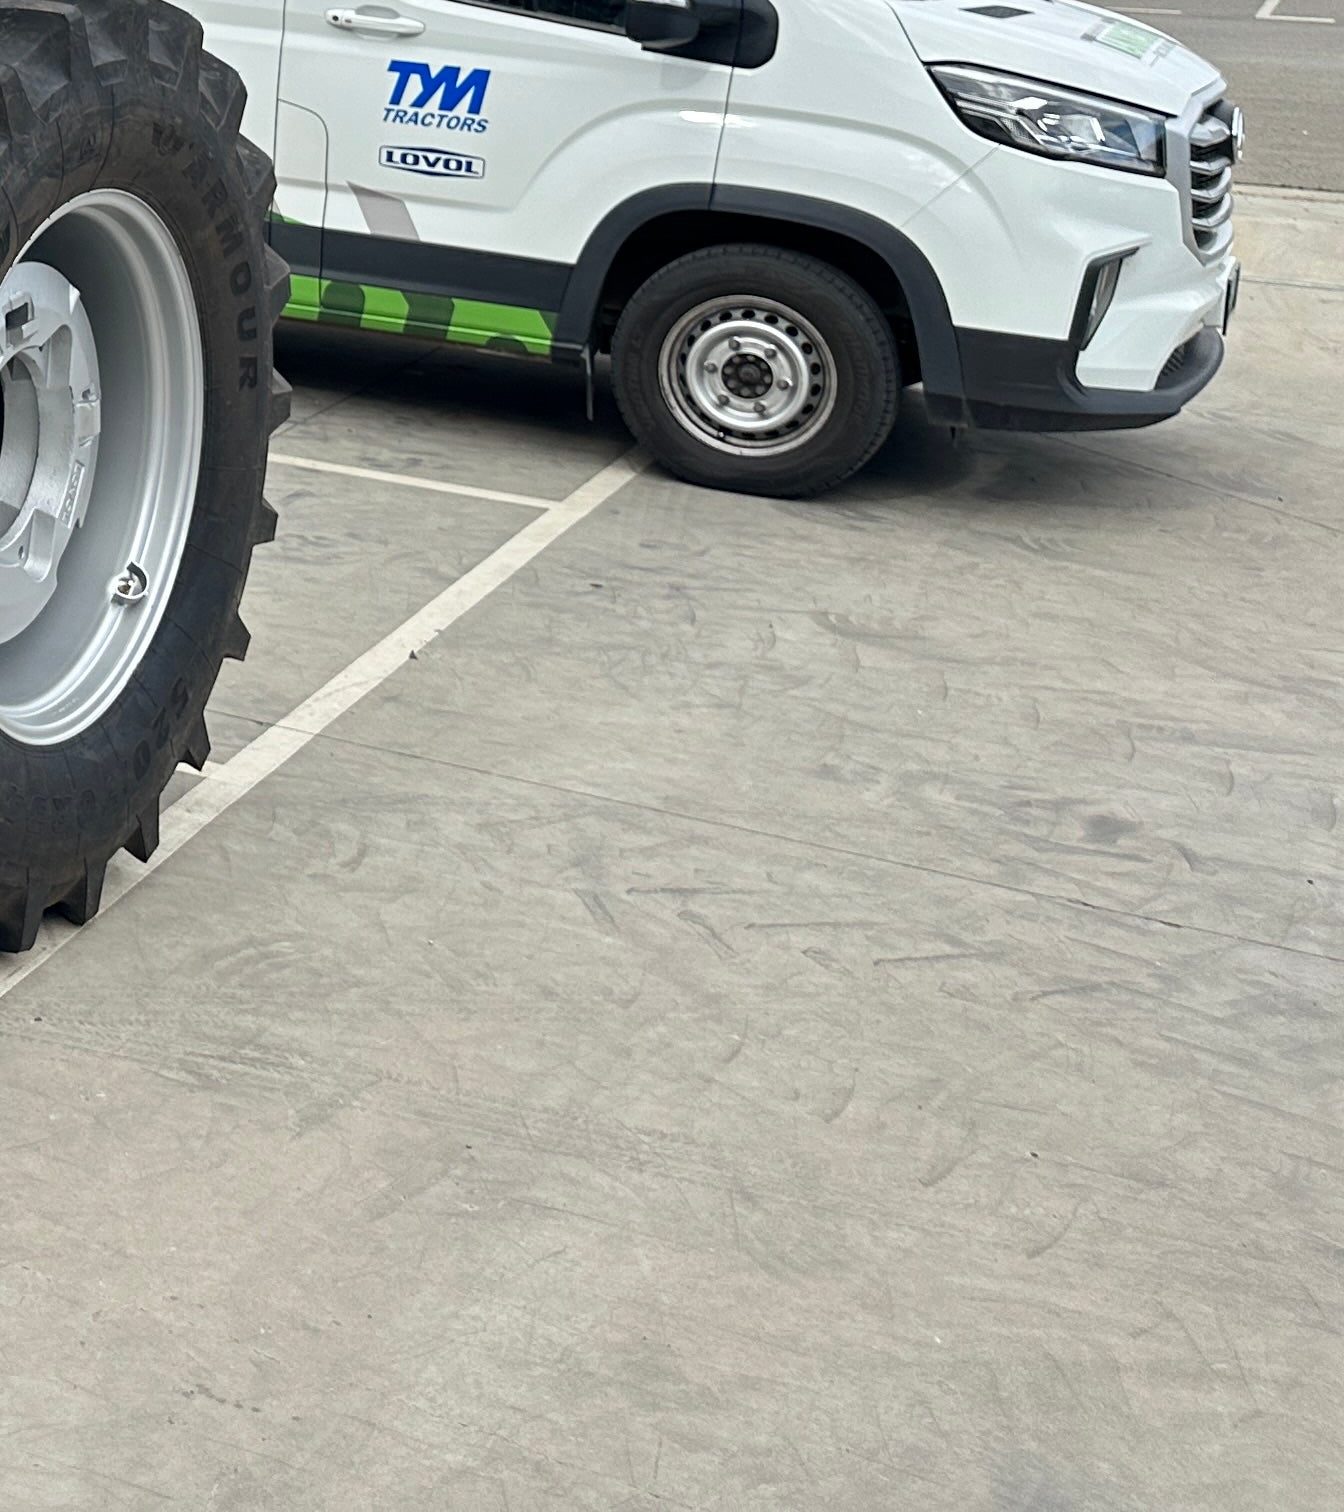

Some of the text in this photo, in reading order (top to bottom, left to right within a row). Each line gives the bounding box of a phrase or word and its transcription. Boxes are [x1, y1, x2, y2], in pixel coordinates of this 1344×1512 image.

[387, 59, 491, 115] TYM
[382, 107, 489, 134] TRACTORS
[386, 150, 479, 175] LOVOL
